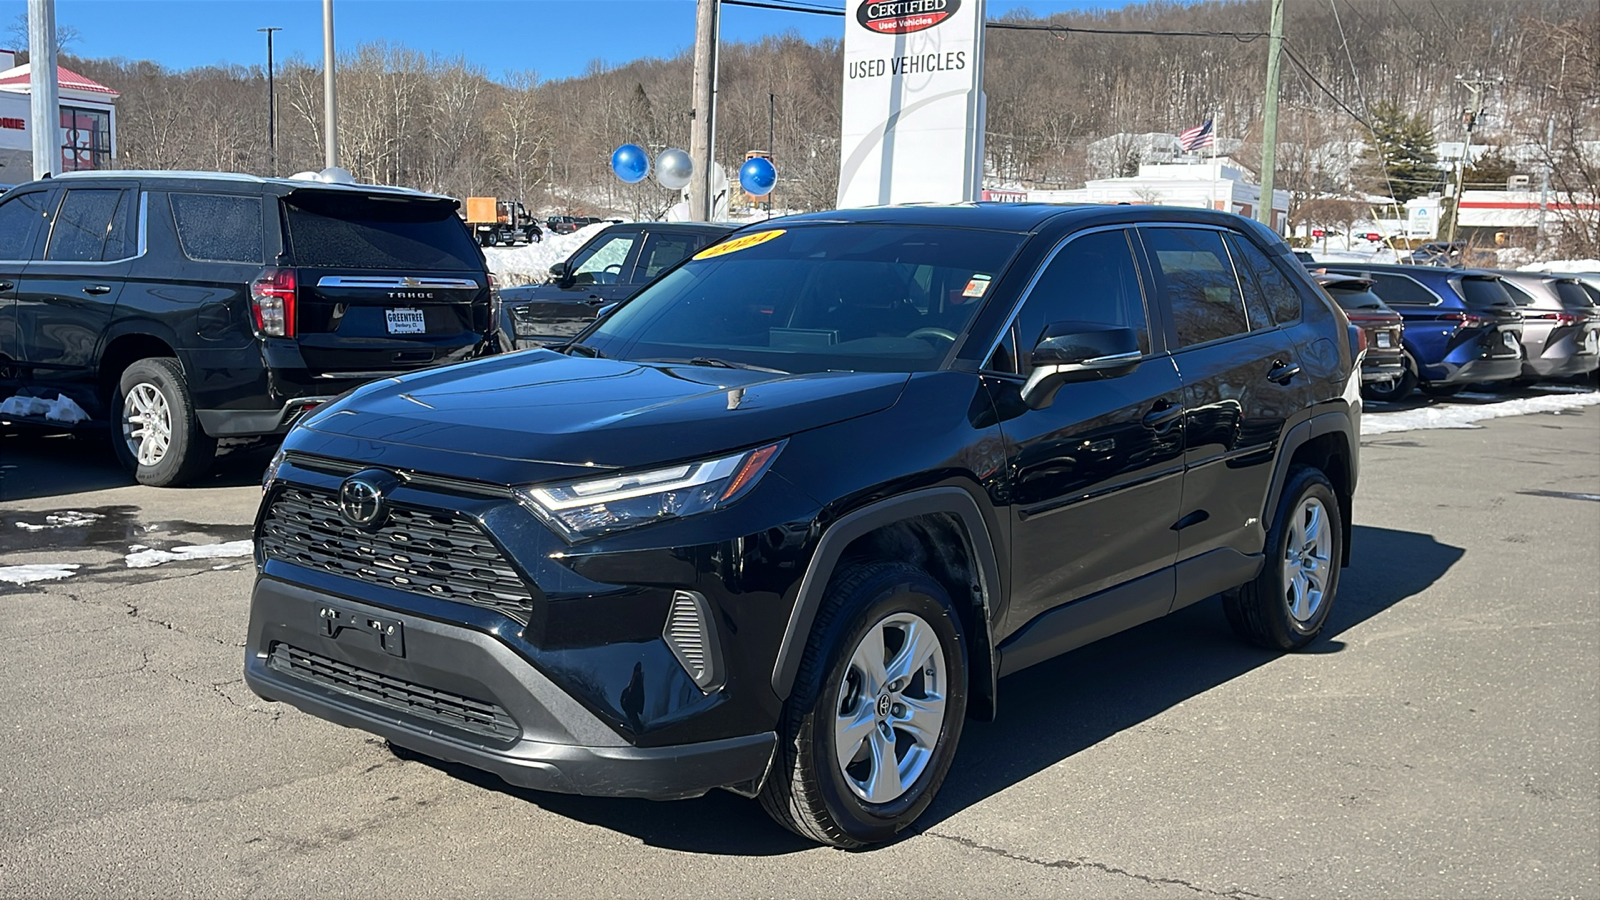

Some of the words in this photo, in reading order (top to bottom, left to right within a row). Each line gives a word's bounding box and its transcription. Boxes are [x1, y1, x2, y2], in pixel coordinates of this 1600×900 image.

[867, 0, 947, 19] CERTIFIED
[878, 21, 898, 30] Used
[899, 17, 933, 28] Vehicles
[849, 58, 886, 79] USED
[890, 51, 966, 75] VEHICLES
[989, 192, 1027, 203] WINES
[387, 313, 423, 323] GREENTREE
